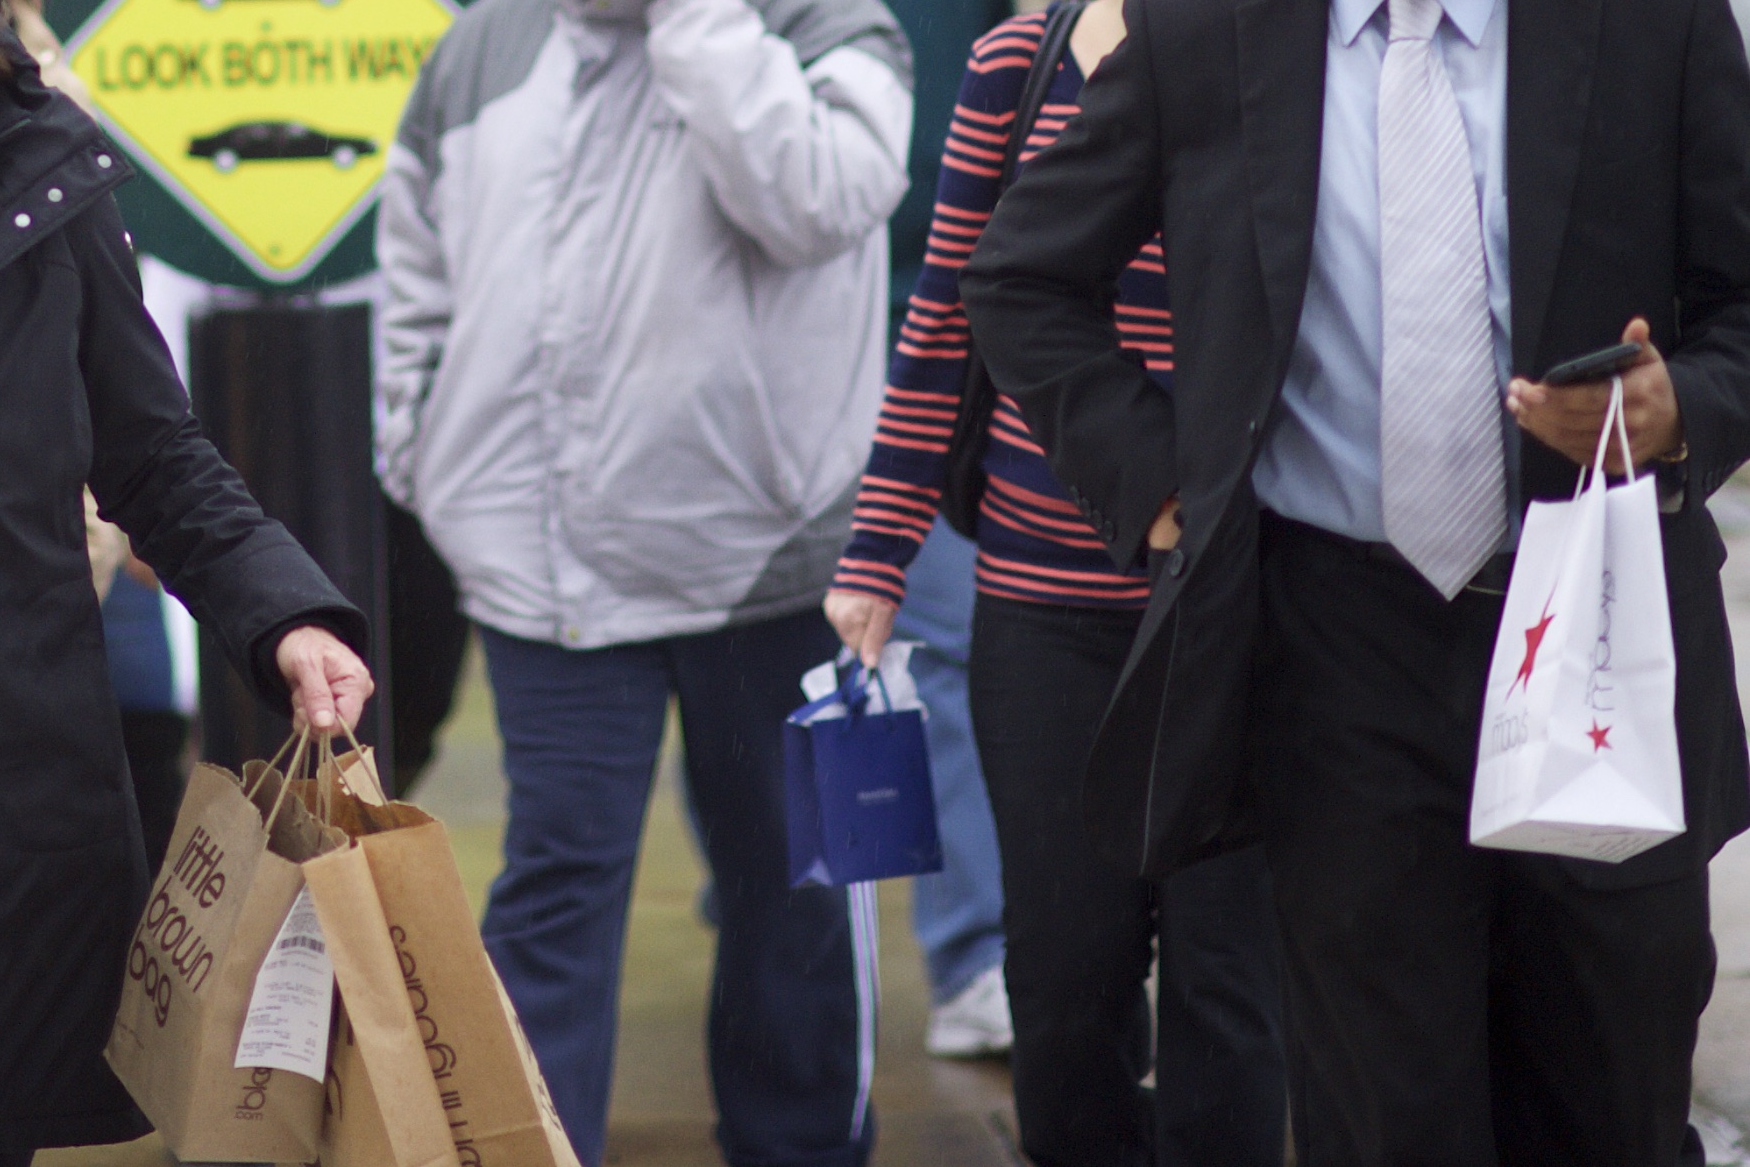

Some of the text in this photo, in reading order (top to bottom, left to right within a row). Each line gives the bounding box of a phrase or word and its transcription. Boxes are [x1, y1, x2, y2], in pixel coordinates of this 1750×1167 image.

[96, 35, 436, 91] LOOK BOTH WAY
[173, 825, 226, 909] little
[128, 923, 172, 1028] bag
[146, 874, 214, 994] brown
